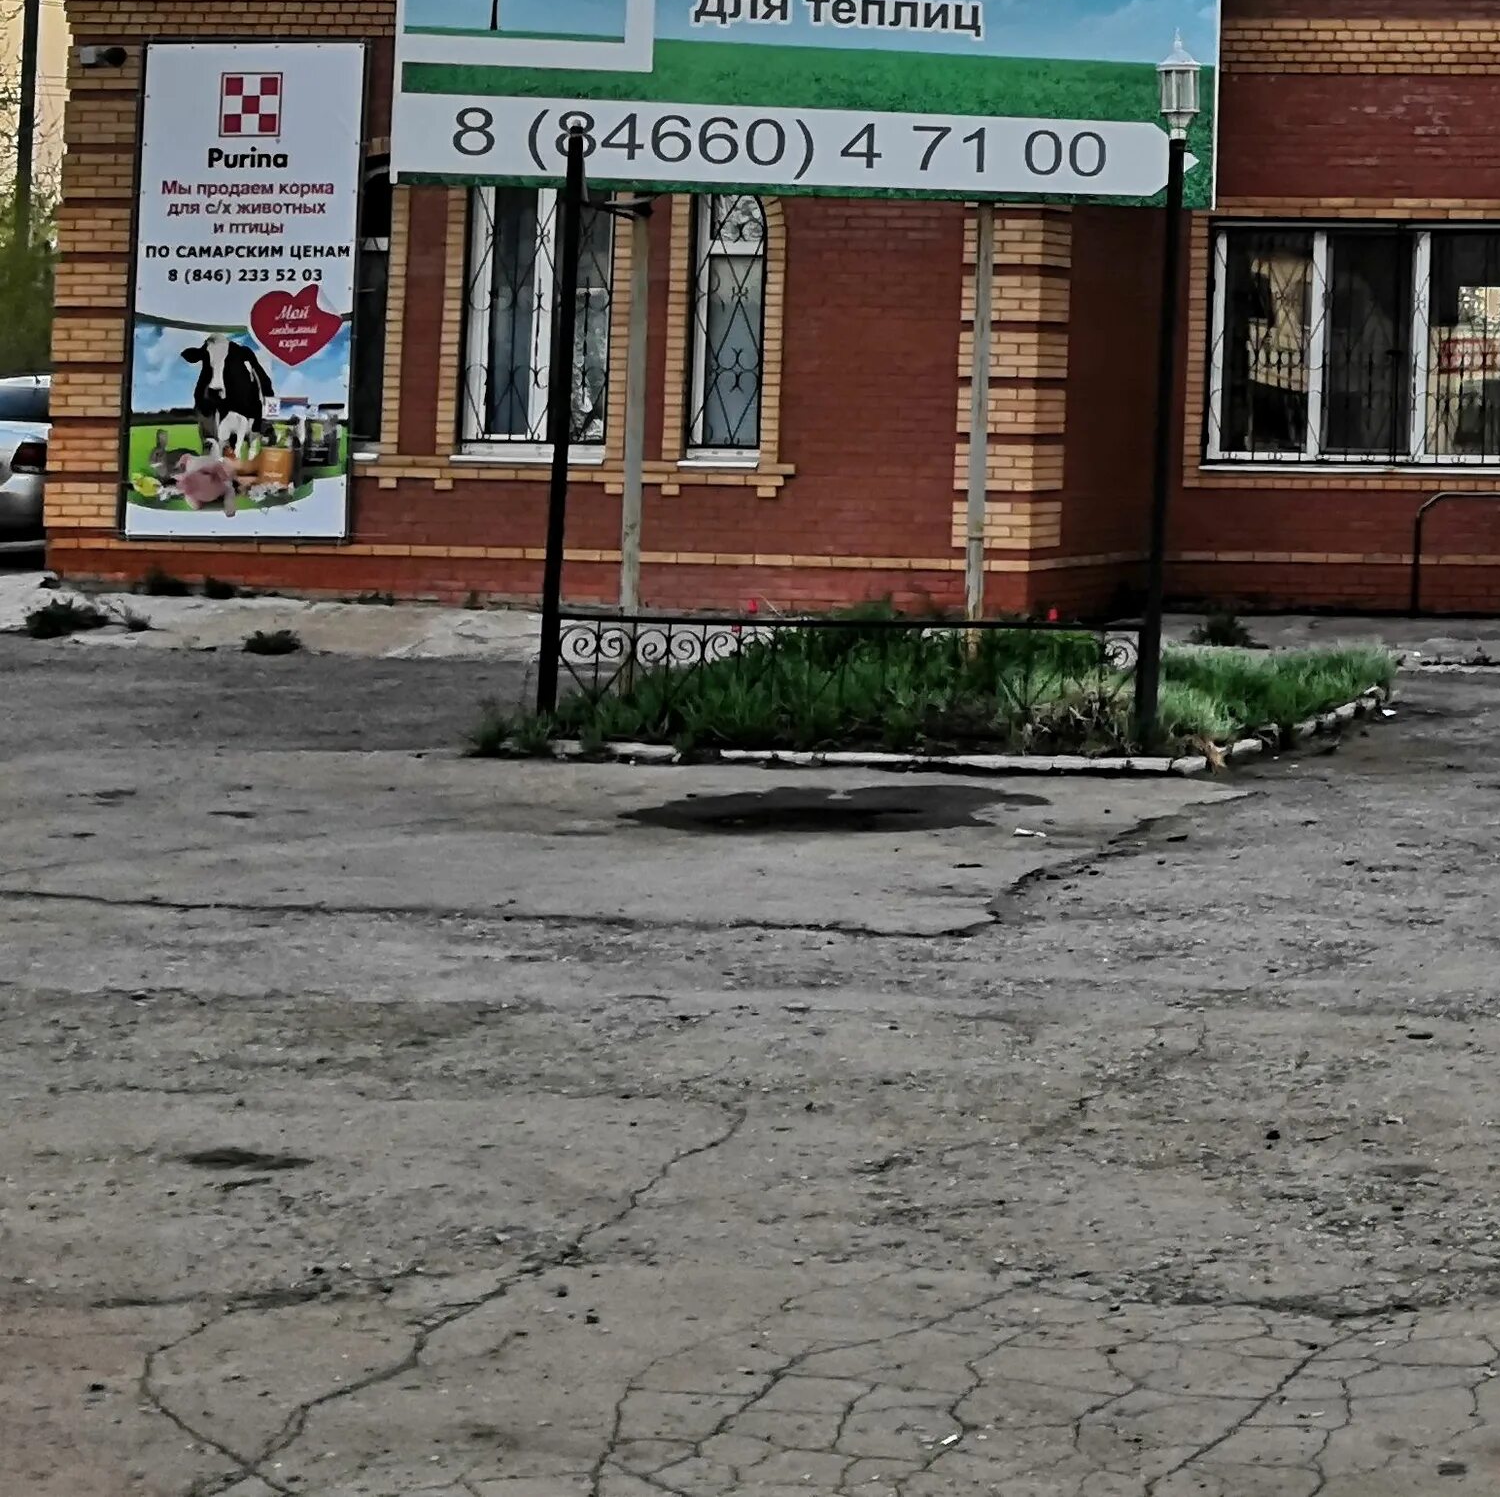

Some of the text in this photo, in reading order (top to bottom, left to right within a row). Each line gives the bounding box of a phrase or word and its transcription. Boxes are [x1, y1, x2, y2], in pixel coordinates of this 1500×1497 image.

[453, 107, 1107, 181] 8 (84660) 4 71 00
[207, 146, 289, 169] Purina
[161, 180, 335, 198] Мы продаем корма
[167, 201, 327, 216] для с/х животных
[213, 222, 284, 237] и птицы
[145, 245, 351, 261] ПО САМАРСКИМ ЦЕНАМ
[168, 268, 323, 285] 8 (846) 233 52 03
